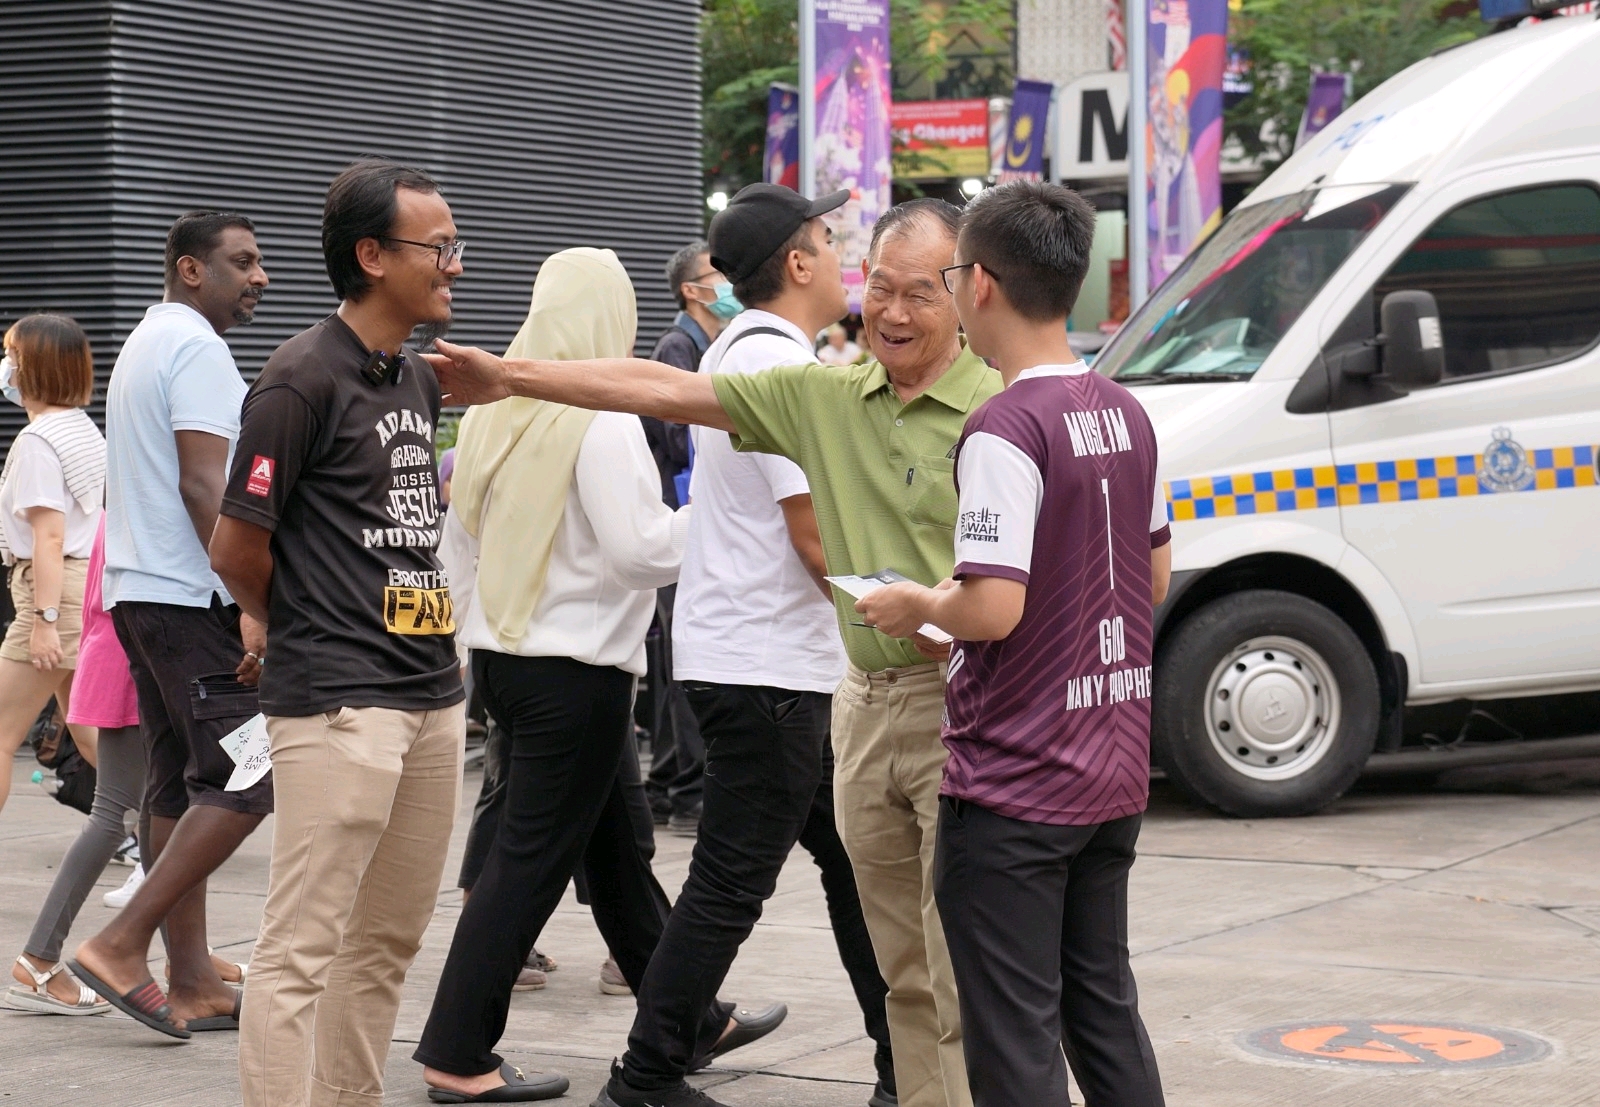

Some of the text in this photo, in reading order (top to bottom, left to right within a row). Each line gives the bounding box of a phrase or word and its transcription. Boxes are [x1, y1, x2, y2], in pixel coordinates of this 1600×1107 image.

[375, 409, 432, 448] ADAM
[1063, 407, 1132, 457] MUSLIM
[393, 472, 433, 488] MOSES
[1101, 478, 1114, 590] 1
[1066, 674, 1104, 711] MANY
